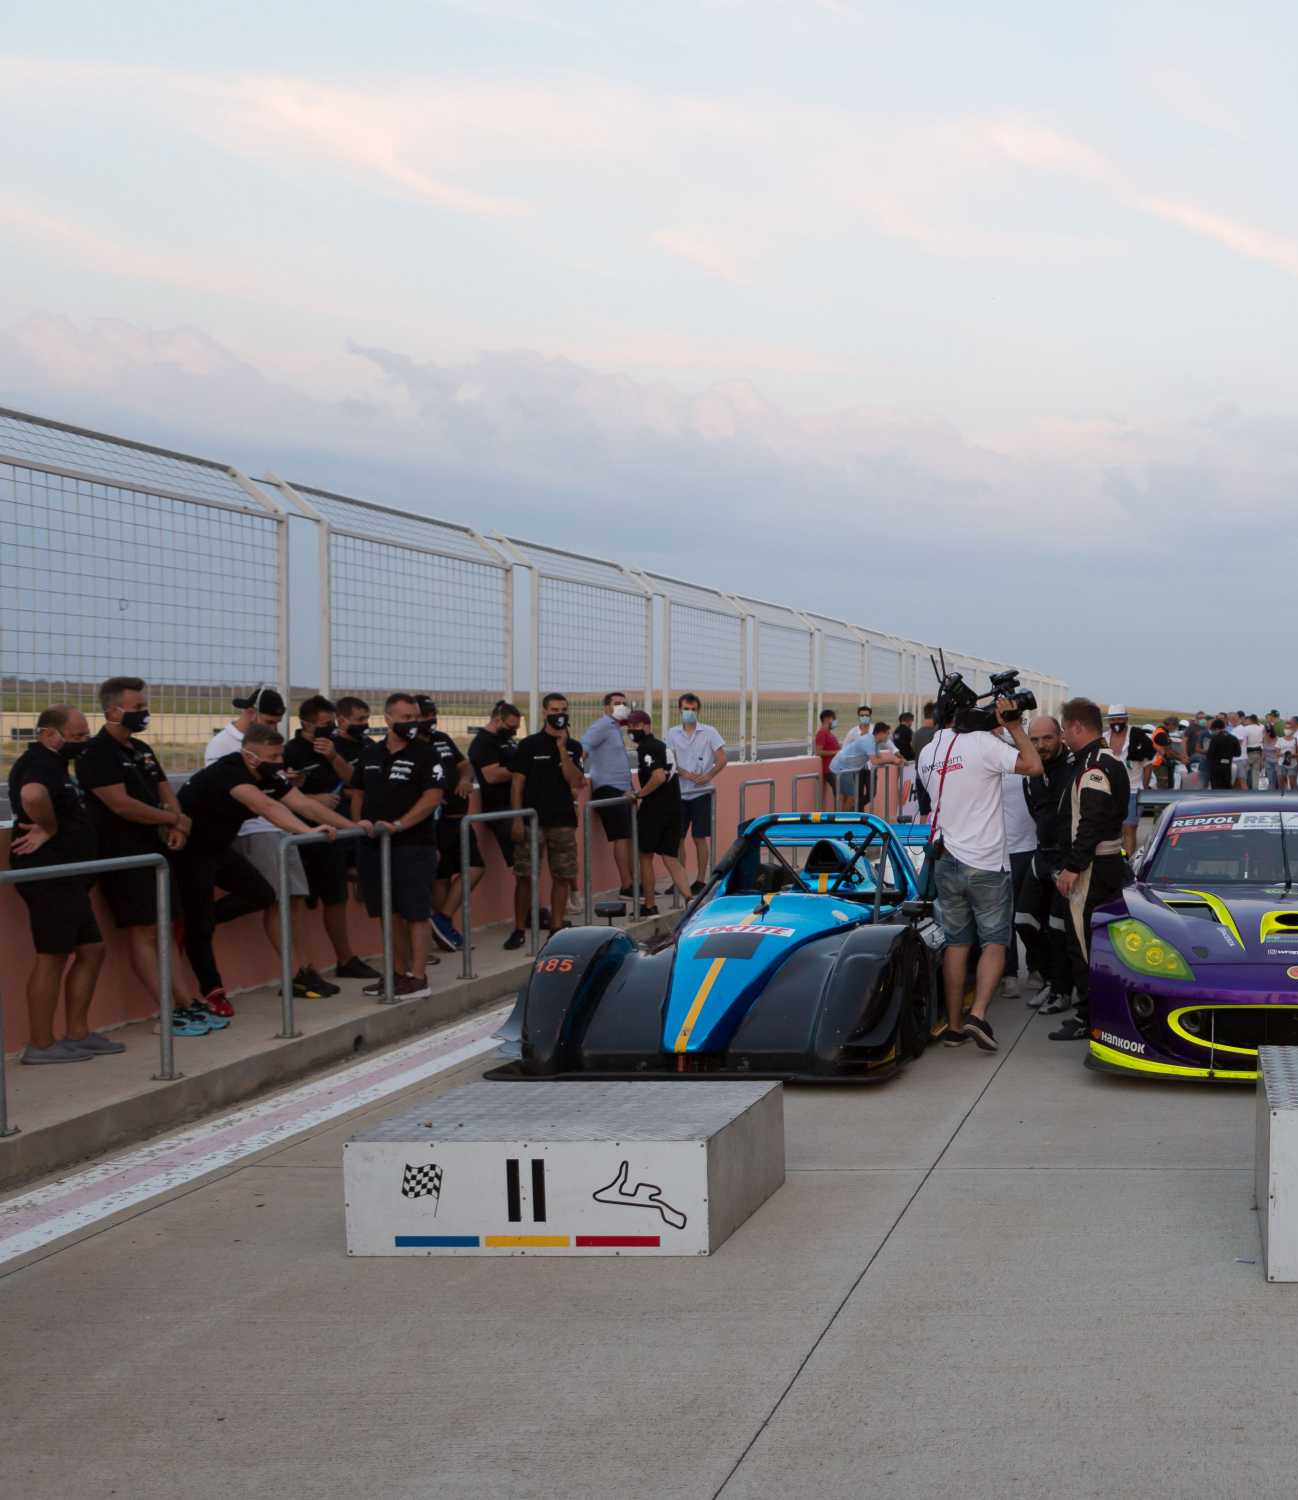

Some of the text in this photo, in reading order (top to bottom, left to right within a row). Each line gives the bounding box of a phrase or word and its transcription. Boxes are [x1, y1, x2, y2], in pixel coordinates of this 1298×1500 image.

[1172, 816, 1234, 828] REPSOL
[695, 924, 790, 936] LOCTITE
[535, 959, 574, 973] 185
